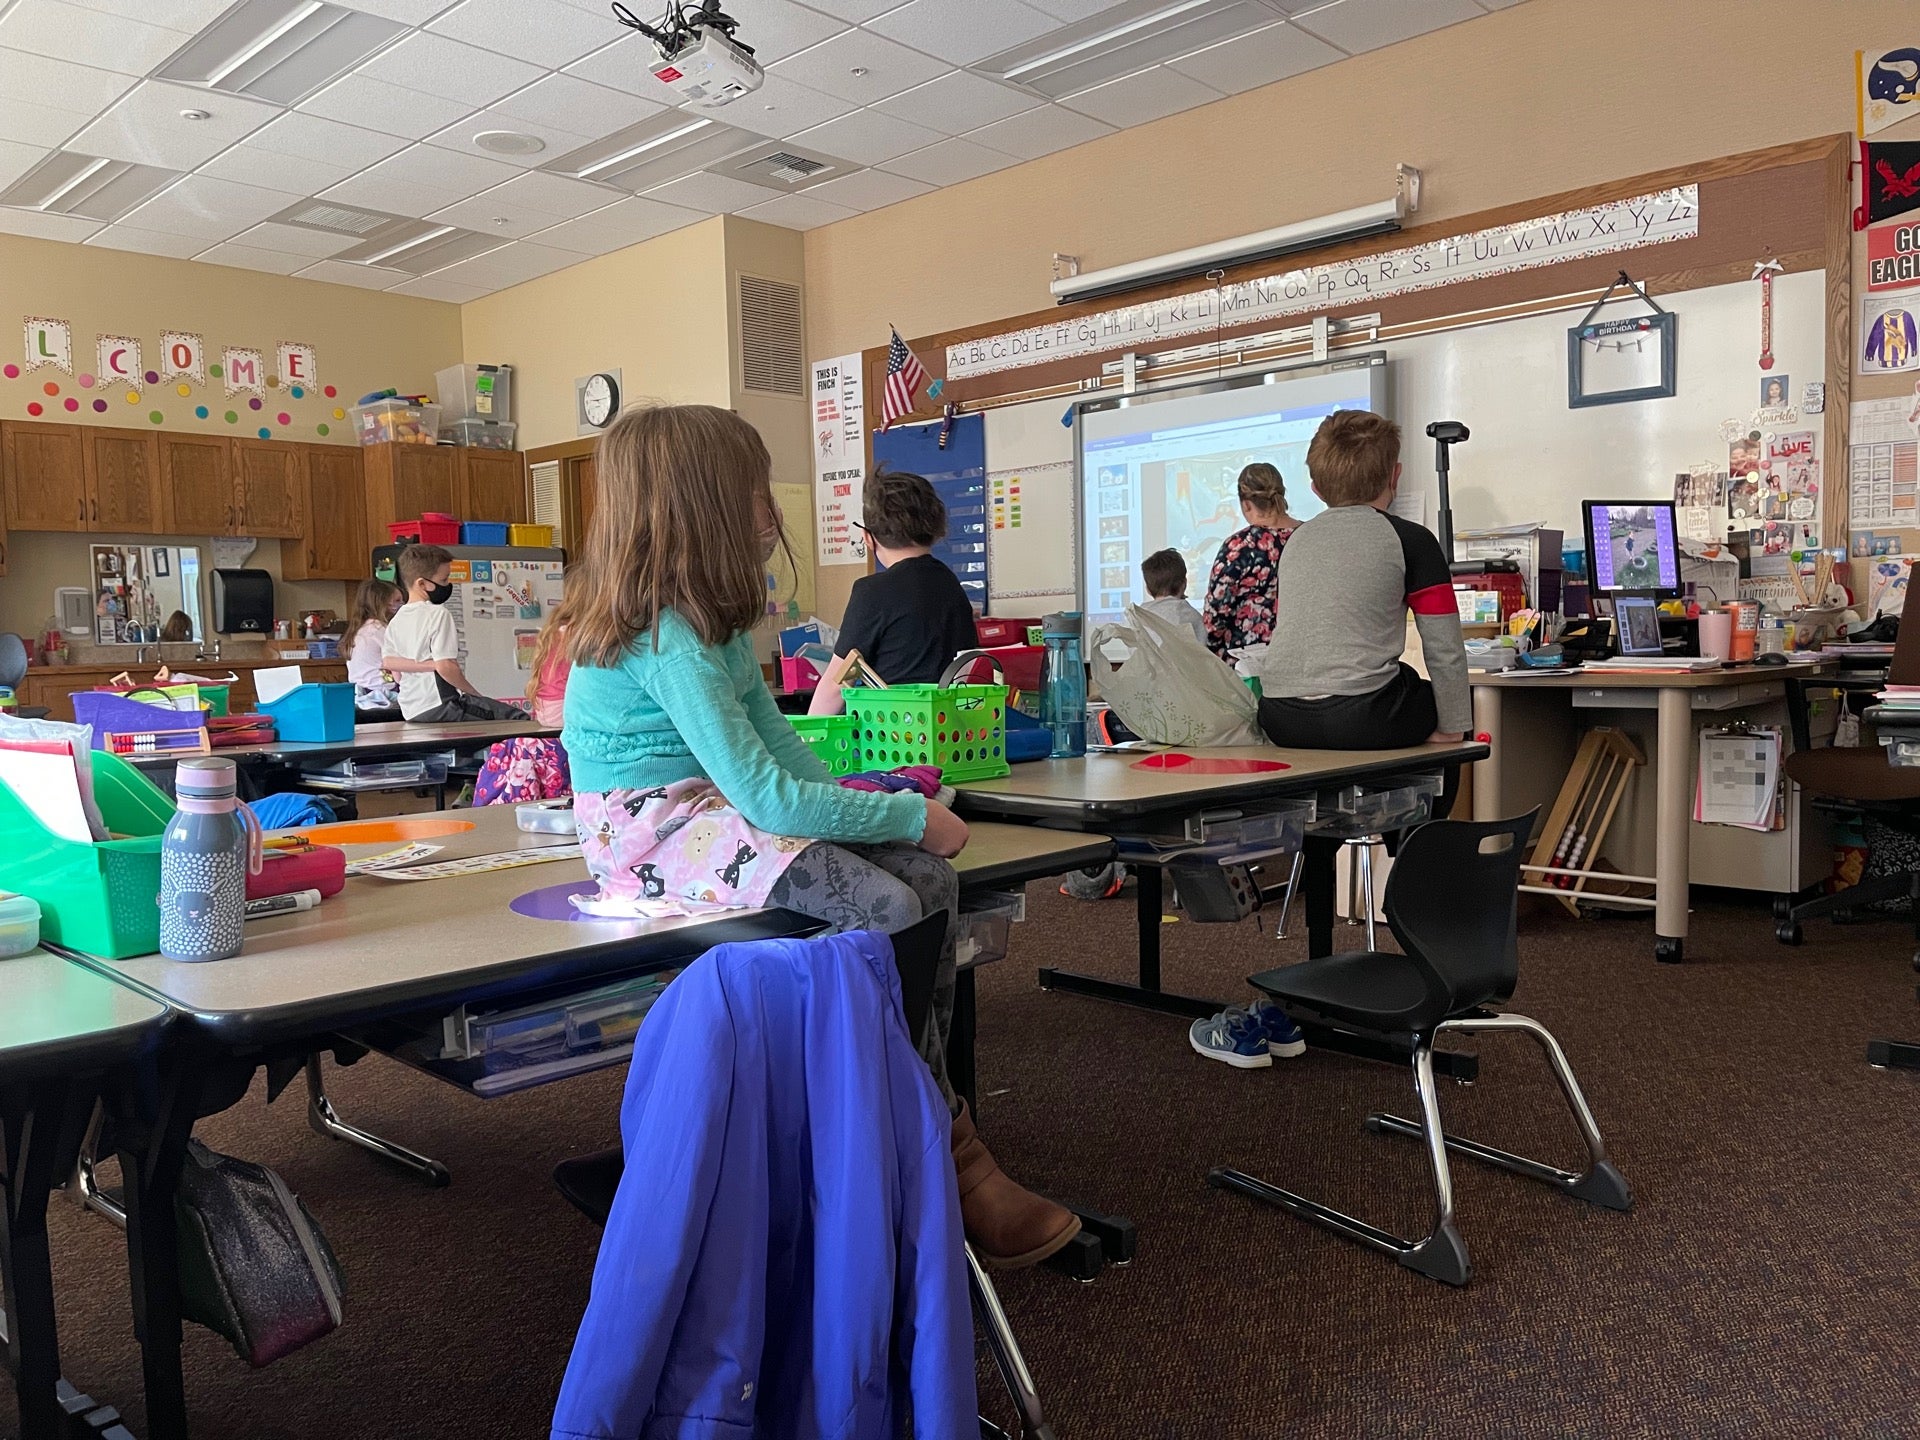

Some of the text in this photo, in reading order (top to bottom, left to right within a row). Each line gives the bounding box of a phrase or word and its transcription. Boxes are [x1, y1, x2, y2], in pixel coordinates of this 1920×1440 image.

[949, 352, 966, 368] Aa
[970, 347, 985, 363] Bb
[991, 342, 1007, 358] Cc
[1012, 337, 1029, 355] Dd
[1035, 334, 1049, 350] Ee
[1056, 326, 1070, 346] Ff
[1077, 324, 1097, 347] Gg
[1103, 317, 1121, 337] Hh
[1145, 309, 1161, 334] Jj
[1170, 303, 1189, 323] Kk
[1222, 293, 1250, 313] Mm
[1257, 285, 1278, 305] Nn
[1284, 281, 1307, 299] Oo
[1317, 274, 1336, 300] Pp
[1344, 268, 1372, 293] Qq
[1380, 261, 1399, 281] Rr
[1412, 255, 1431, 274] Ss
[1446, 246, 1461, 268] Tt
[1474, 239, 1498, 261] Uu
[1512, 231, 1534, 252] Vv
[1542, 222, 1580, 246] Ww
[1589, 214, 1616, 238] Xx
[1629, 206, 1655, 237] Yy
[1666, 200, 1692, 222] Zz
[1599, 323, 1637, 335] BIRTHDAY
[1604, 318, 1630, 328] HAPPY
[816, 366, 838, 380] THIS IS
[818, 378, 836, 391] FINCH
[822, 471, 837, 482] BEFORE
[838, 470, 847, 480] YOU
[833, 484, 851, 497] THINK
[1211, 1028, 1224, 1046] N
